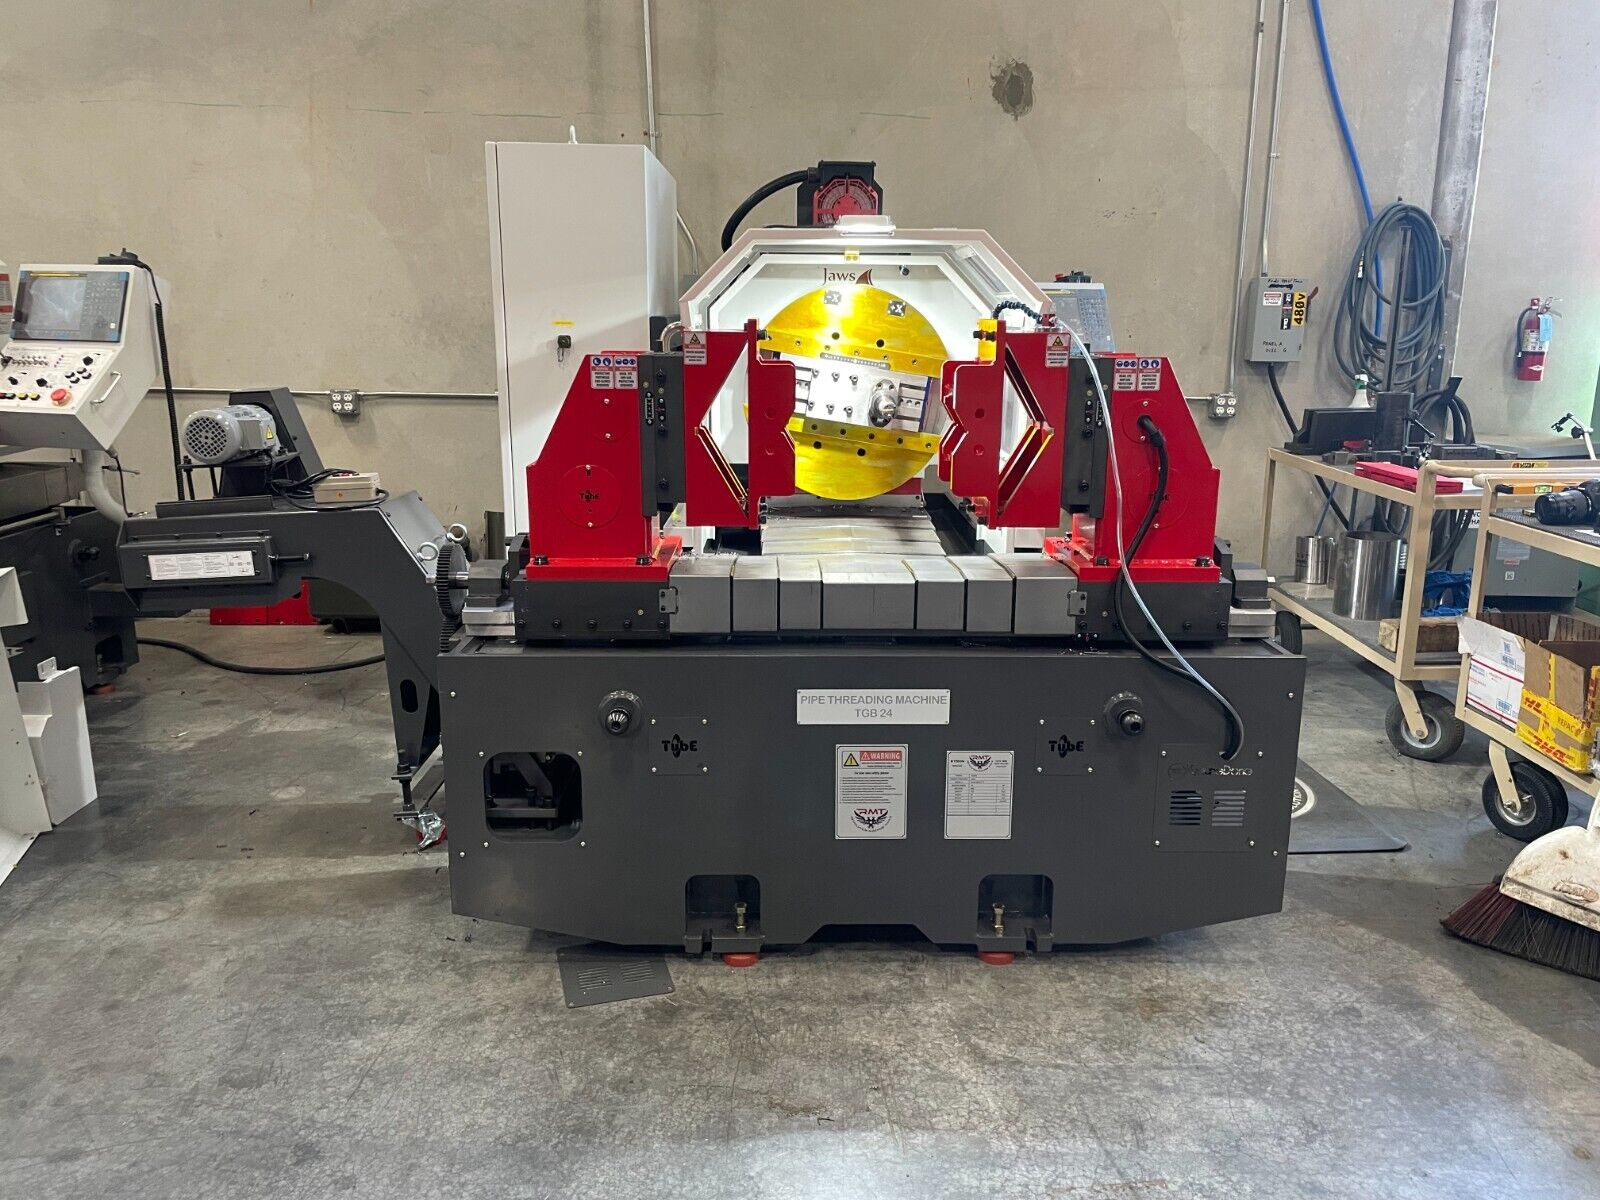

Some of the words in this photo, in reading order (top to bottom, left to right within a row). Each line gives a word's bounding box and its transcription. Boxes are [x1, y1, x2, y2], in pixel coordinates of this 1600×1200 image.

[823, 267, 856, 285] Jaws
[800, 695, 826, 705] PIPE
[826, 695, 894, 705] THREADING
[895, 695, 948, 705] MACHINE
[855, 708, 878, 718] TGB
[879, 708, 893, 718] 24
[870, 752, 901, 760] WARNING
